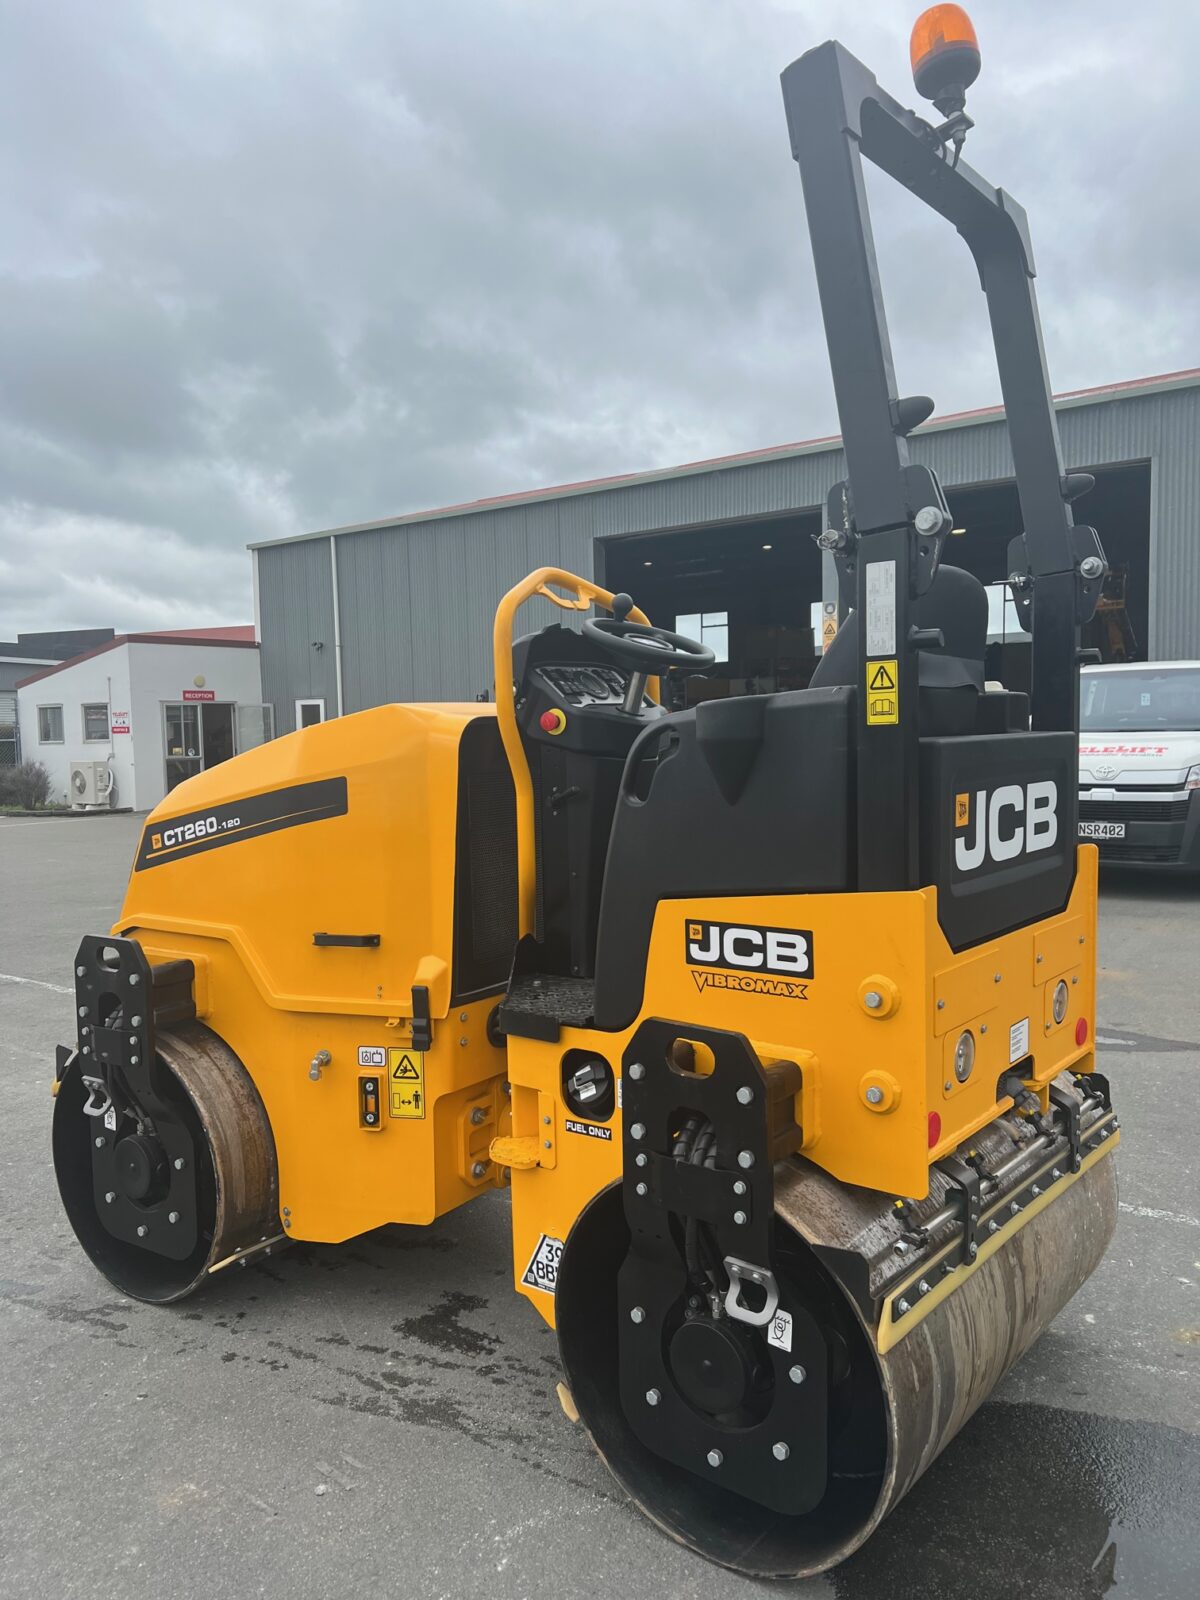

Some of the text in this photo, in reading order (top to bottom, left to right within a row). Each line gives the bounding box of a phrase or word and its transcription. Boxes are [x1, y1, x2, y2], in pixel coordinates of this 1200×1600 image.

[955, 780, 1058, 871] JCB
[1079, 824, 1124, 836] NSR402
[689, 925, 809, 973] JCB
[691, 970, 808, 1000] VIBROMAX
[566, 1121, 611, 1139] FUEL ONLY
[535, 1260, 558, 1283] BB
